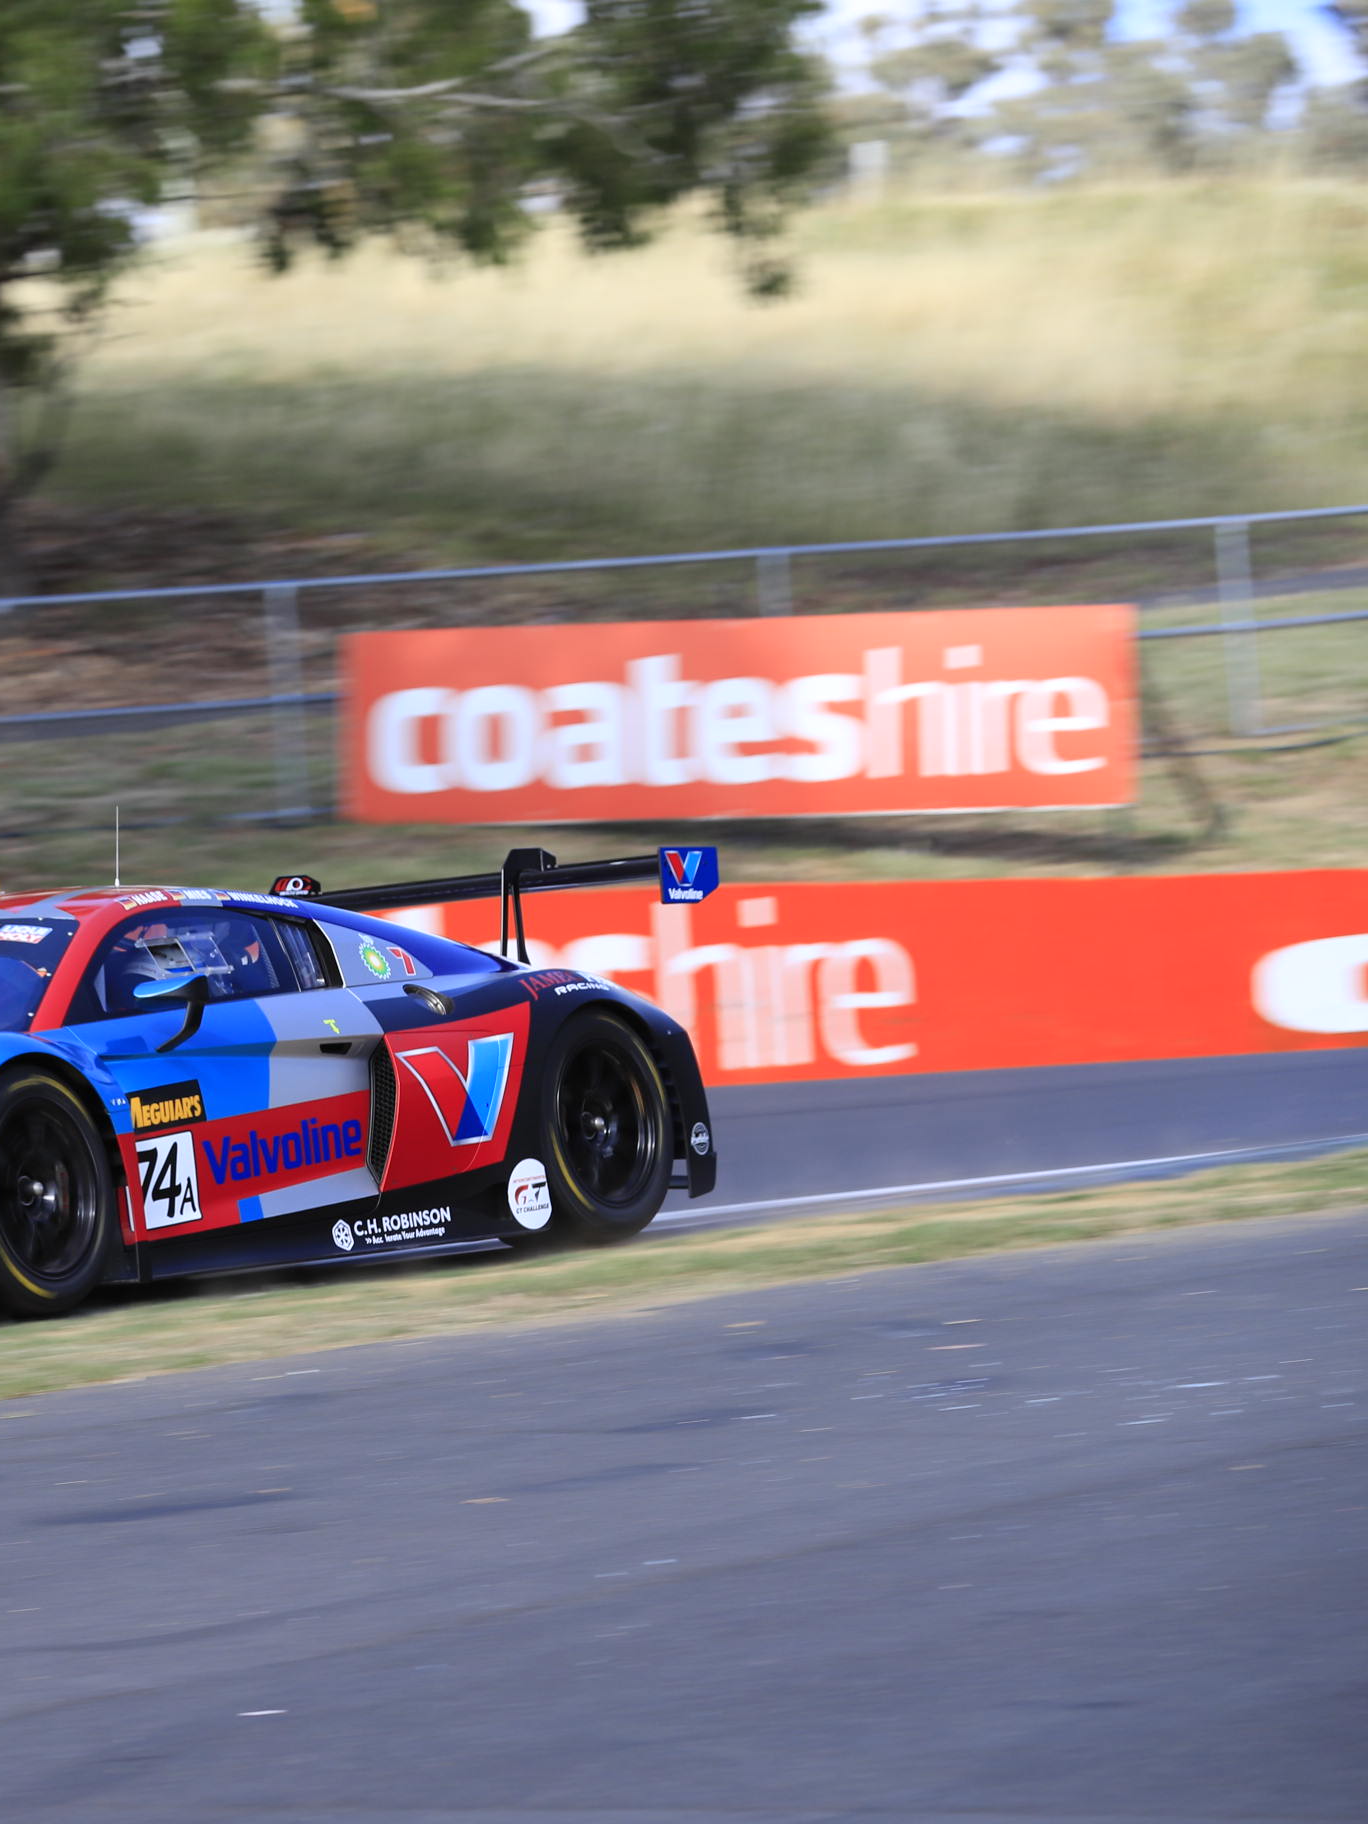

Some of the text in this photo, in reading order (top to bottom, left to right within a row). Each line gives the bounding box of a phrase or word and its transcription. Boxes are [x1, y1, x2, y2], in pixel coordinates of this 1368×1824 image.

[668, 888, 703, 900] Valvoline
[554, 982, 611, 996] RACING
[130, 1094, 202, 1129] MEGUIAR'S
[202, 1117, 362, 1185] Valvoline
[523, 1203, 550, 1213] CHALLENGE
[354, 1206, 451, 1236] C.H. ROBINSON
